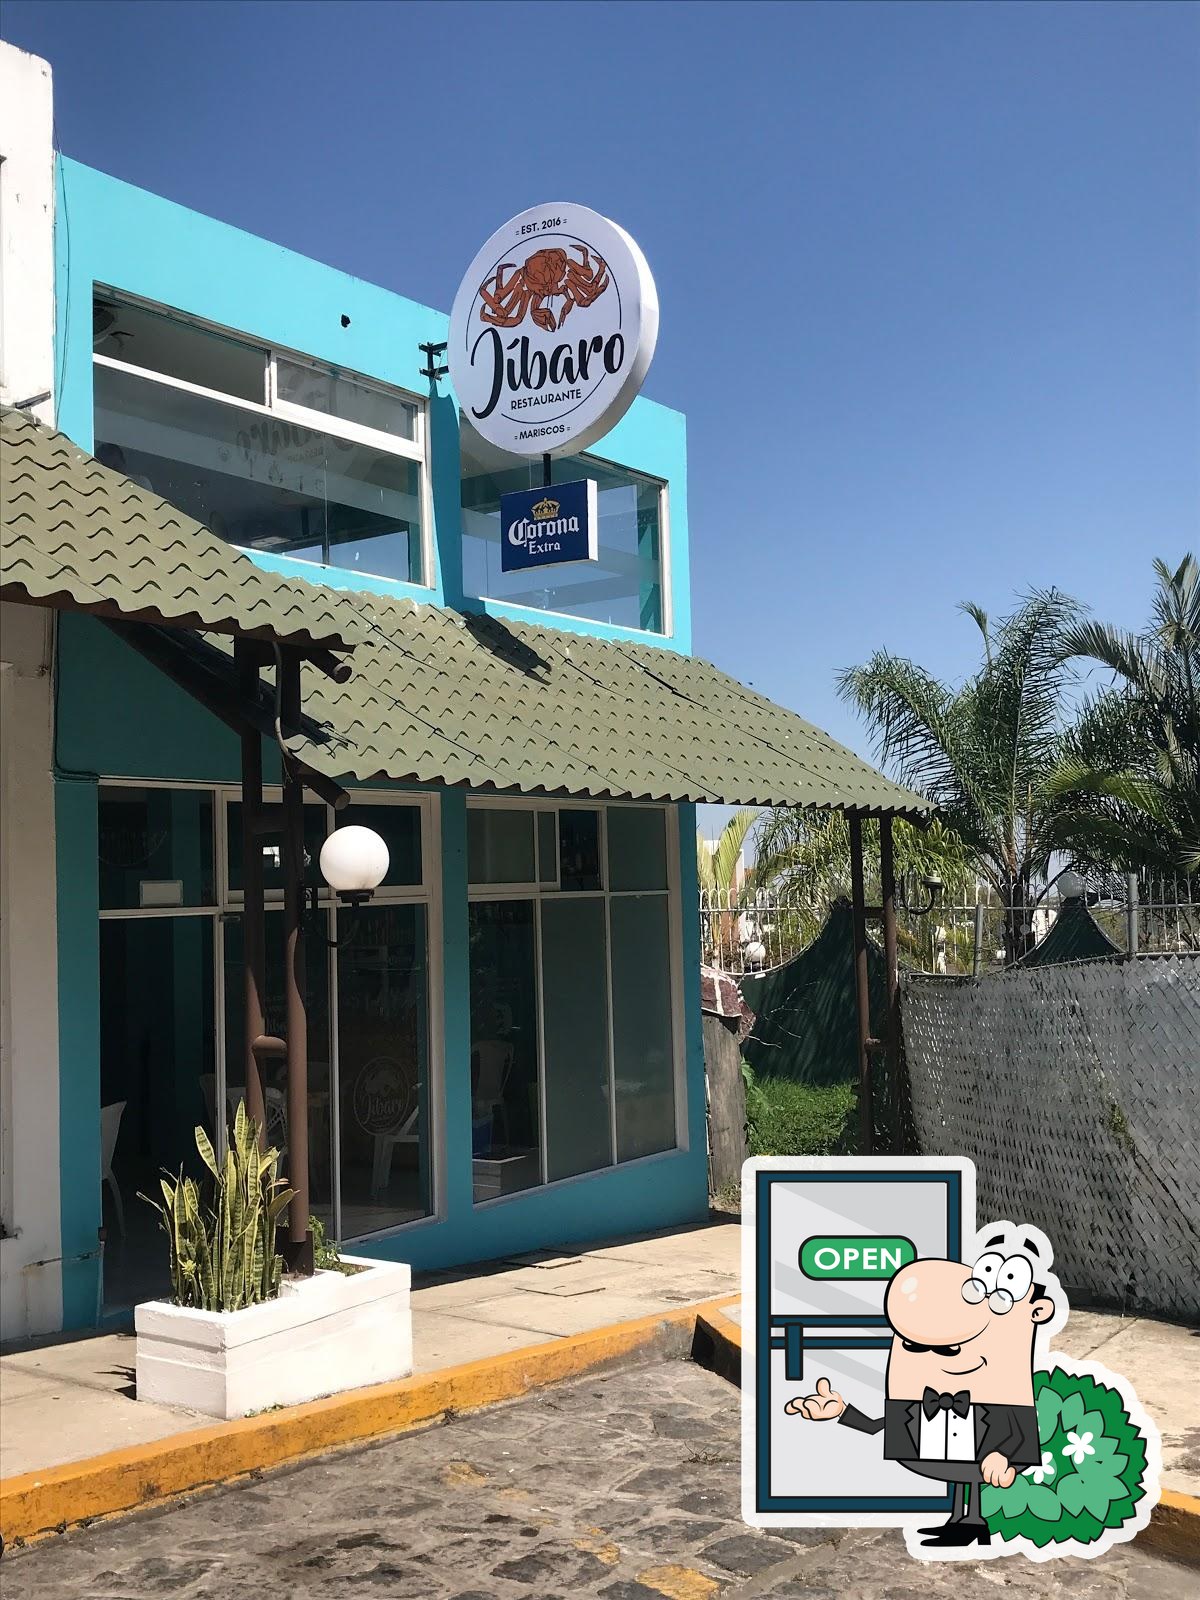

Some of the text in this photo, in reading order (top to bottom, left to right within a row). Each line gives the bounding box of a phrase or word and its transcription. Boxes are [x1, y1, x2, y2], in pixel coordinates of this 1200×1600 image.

[521, 217, 561, 235] EST. 2016
[471, 327, 625, 419] Jíbaro
[511, 388, 582, 410] RESTAURANTE
[519, 424, 565, 440] MARISCOS
[508, 516, 580, 548] Corona
[528, 540, 561, 555] Extra
